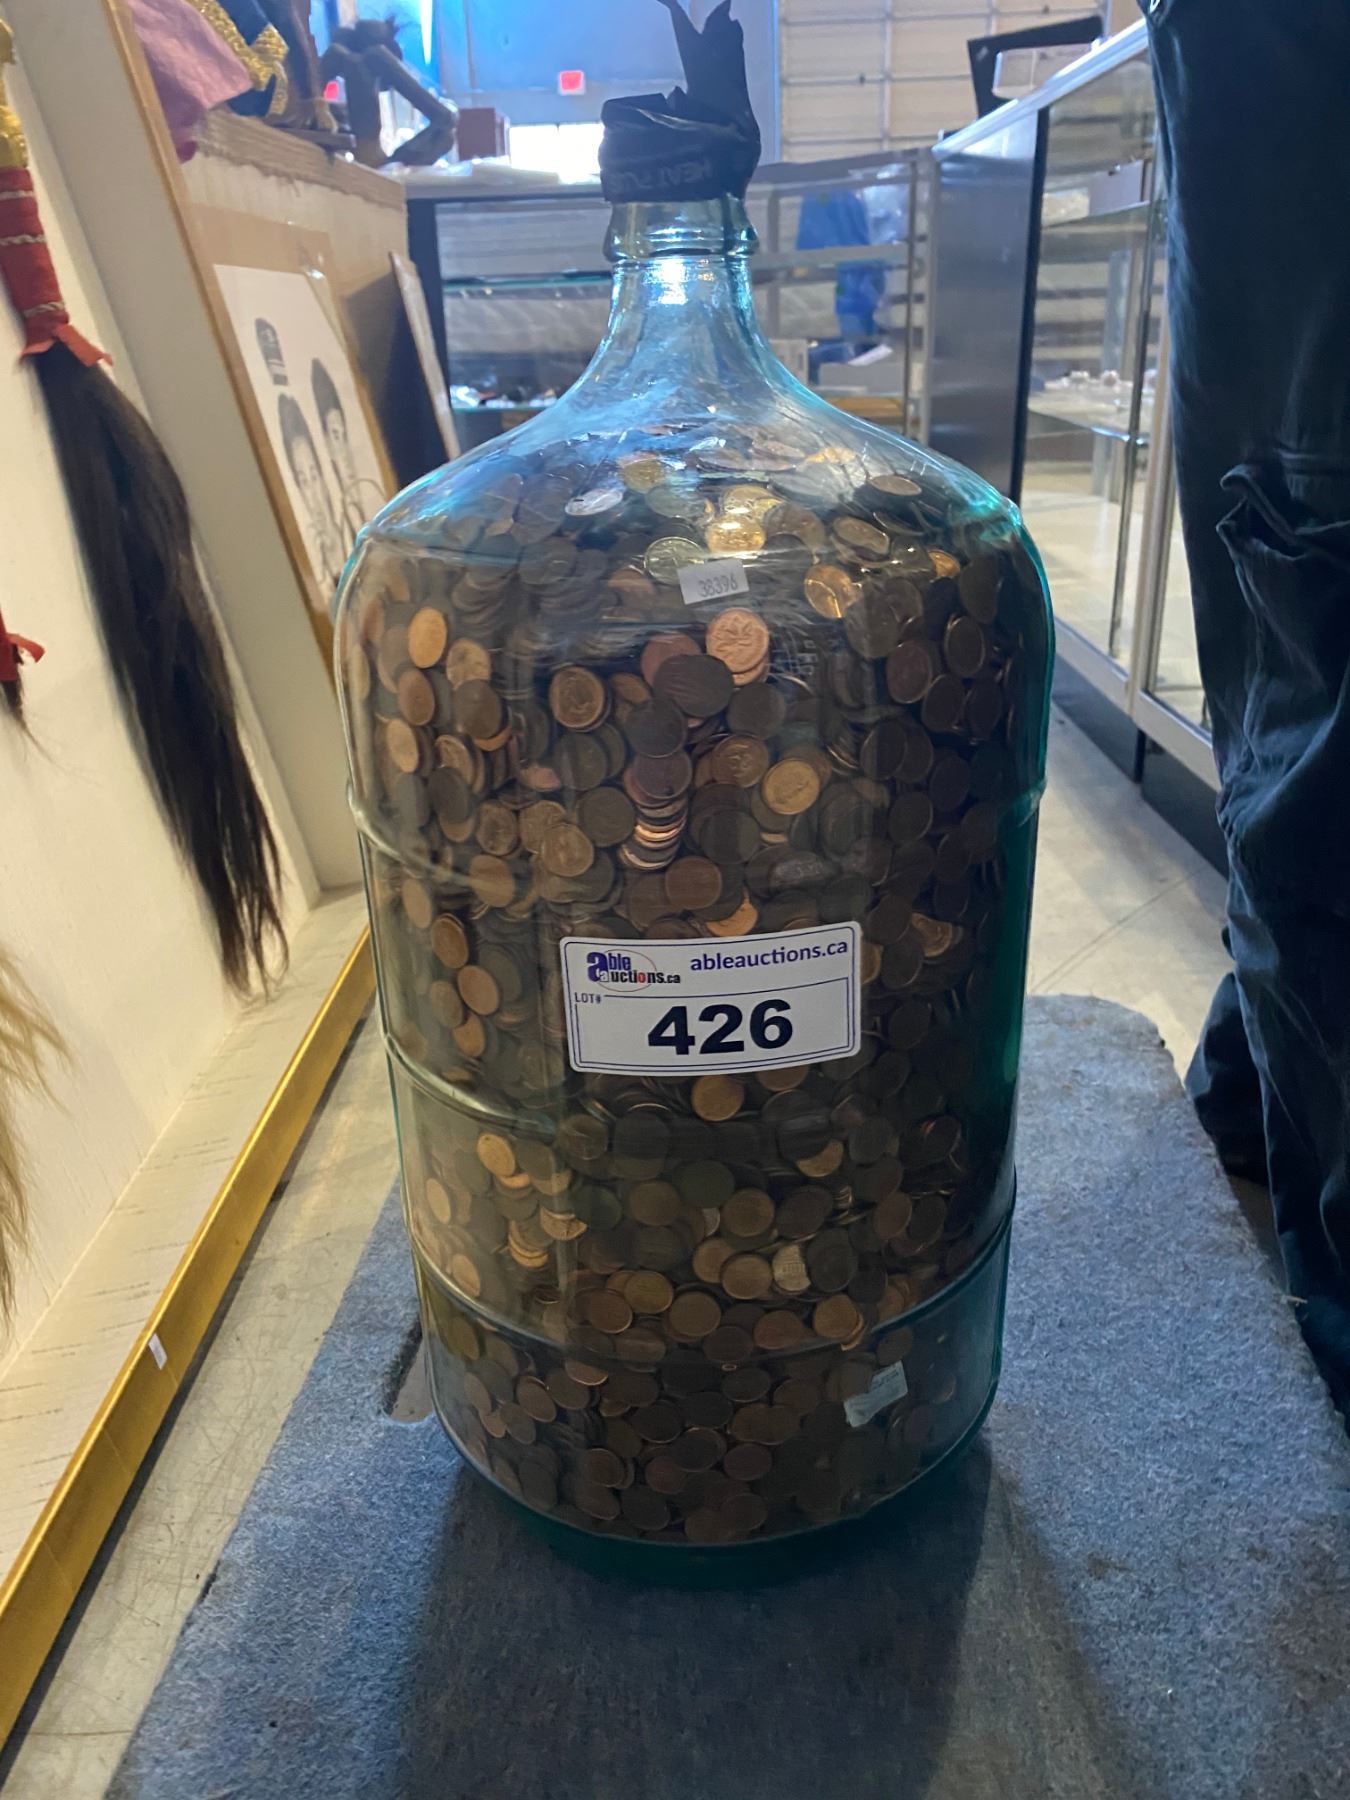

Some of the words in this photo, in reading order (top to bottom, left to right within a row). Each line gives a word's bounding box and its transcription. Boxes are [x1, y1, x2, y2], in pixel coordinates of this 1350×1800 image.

[690, 941, 848, 971] ableauctions.ca
[574, 992, 602, 1004] LOT#
[647, 999, 793, 1056] 426
